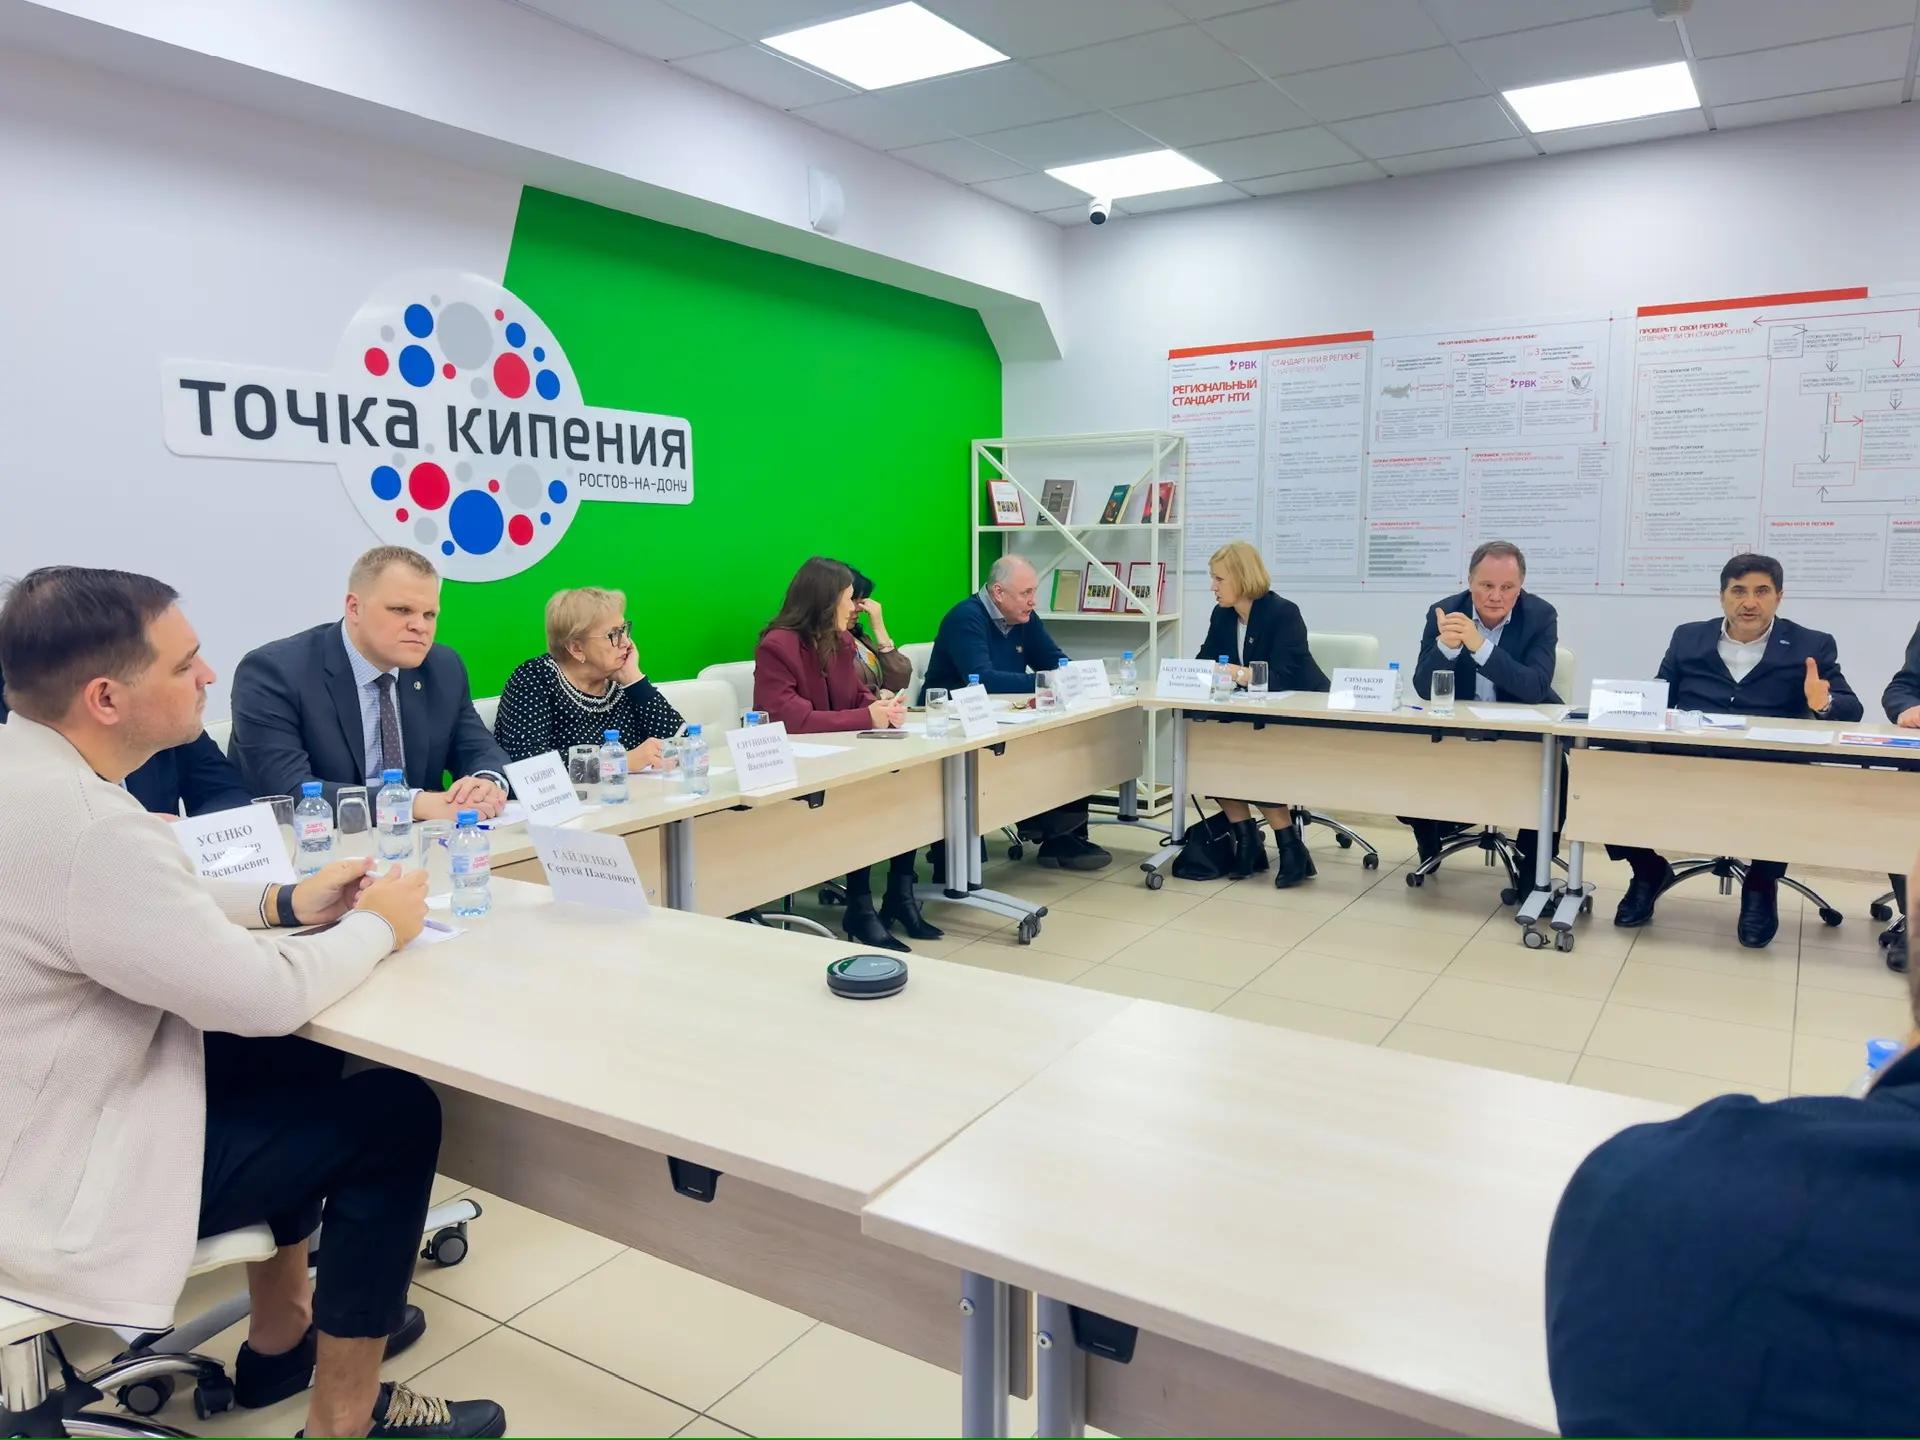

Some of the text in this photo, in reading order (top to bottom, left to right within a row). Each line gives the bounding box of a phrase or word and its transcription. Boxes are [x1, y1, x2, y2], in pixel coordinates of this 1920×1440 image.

[1238, 360, 1257, 371] РВК
[1172, 376, 1258, 395] РЕГИОНАЛЬНЫЙ
[1518, 379, 1537, 388] РВК
[1172, 391, 1250, 407] СТАНДАРТ НТИ
[578, 472, 688, 494] РОСТОВ-НА-ДОНУ
[196, 824, 253, 847] УСЕНКО
[547, 862, 636, 885] Сергей Павлович
